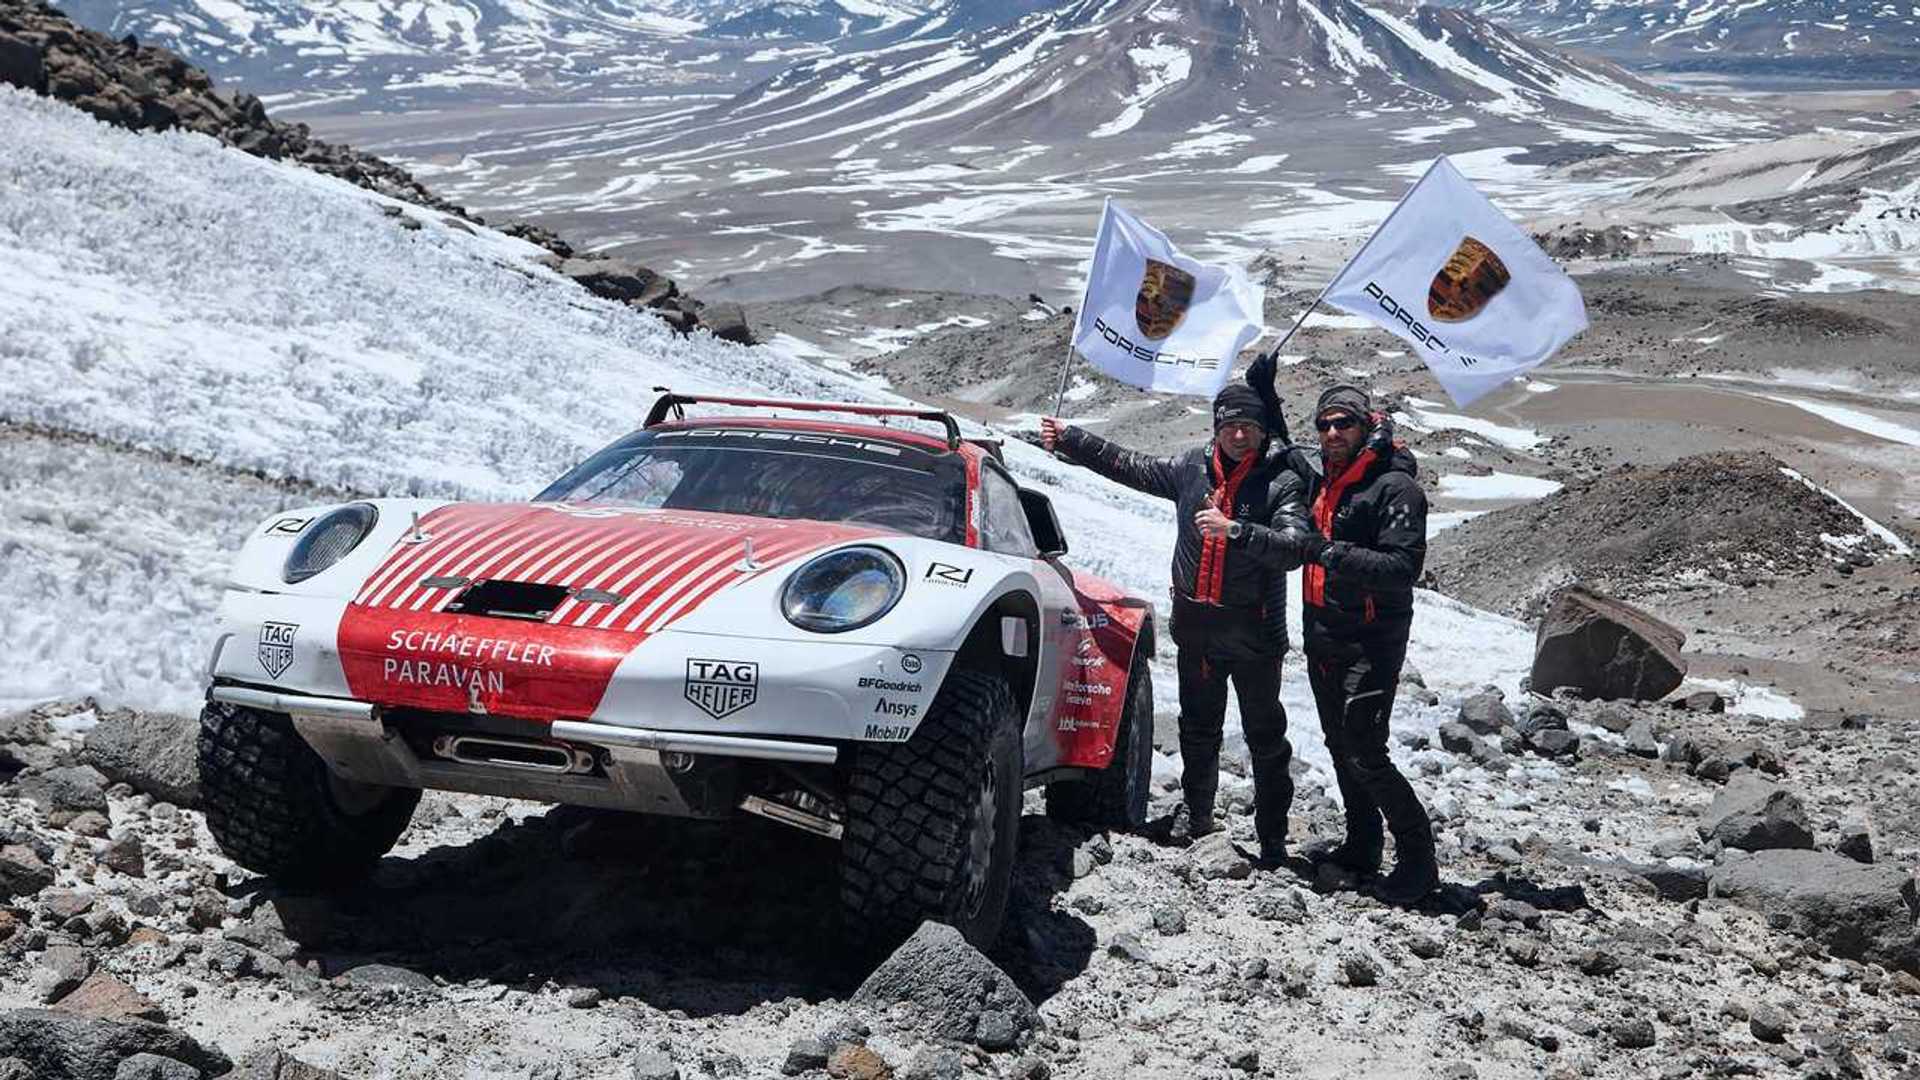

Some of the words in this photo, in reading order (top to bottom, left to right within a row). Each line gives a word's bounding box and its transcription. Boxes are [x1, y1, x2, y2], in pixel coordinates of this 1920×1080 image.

[1363, 281, 1478, 368] PORSCE
[1094, 317, 1219, 370] PORSCHE
[265, 625, 293, 643] TAG
[386, 630, 555, 666] SCHAEFFLER
[384, 658, 504, 694] PARAVAN
[693, 662, 752, 682] TAG
[858, 677, 922, 693] BFGoodrich
[689, 685, 753, 715] HEUER
[875, 697, 918, 719] Ansys
